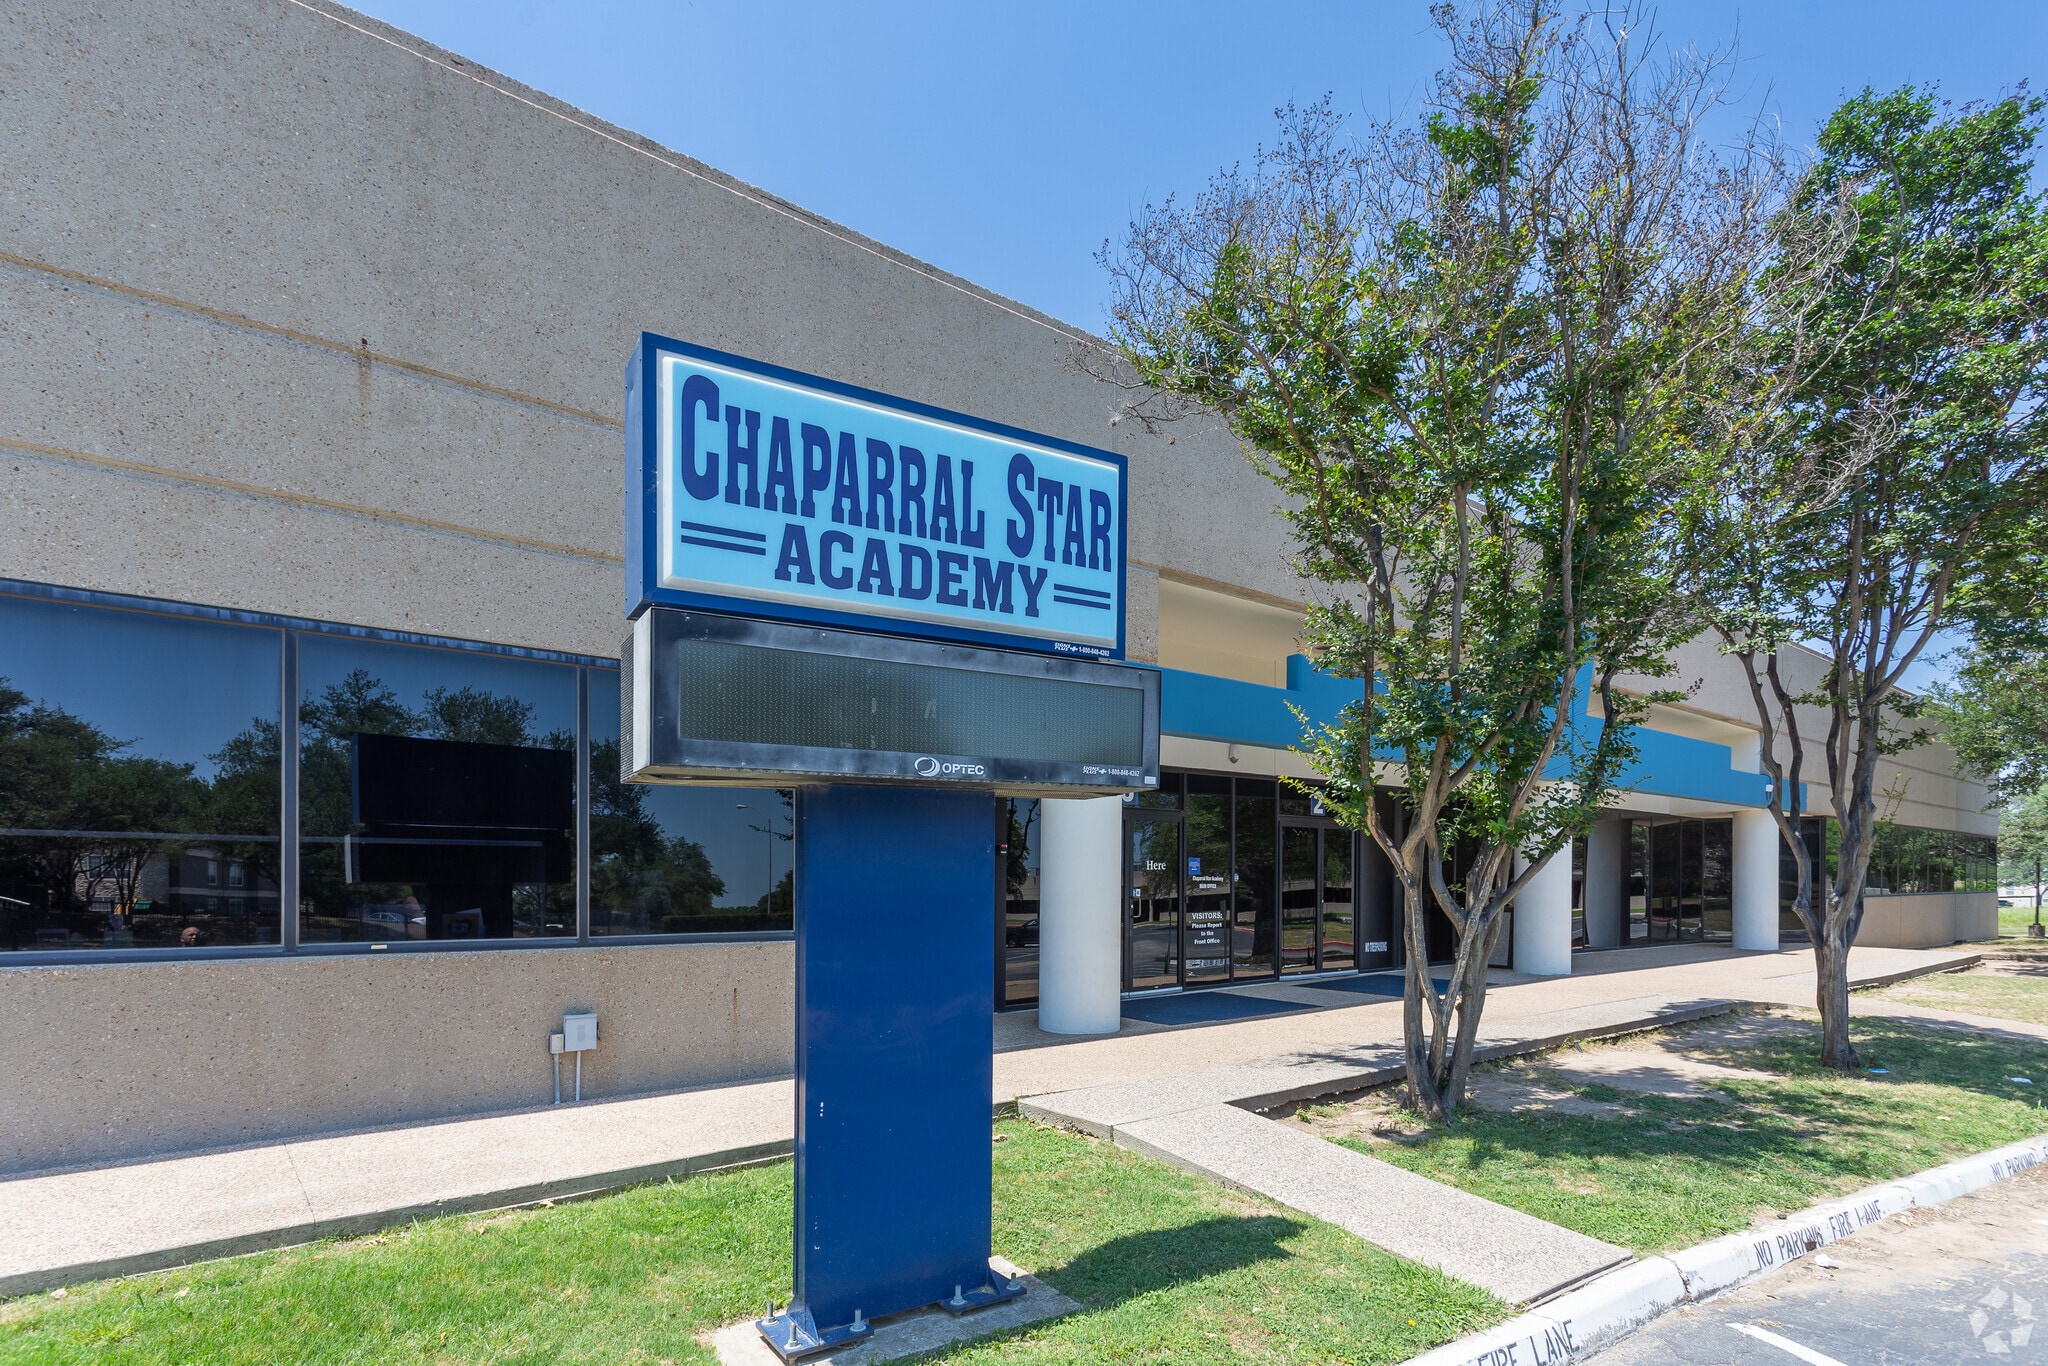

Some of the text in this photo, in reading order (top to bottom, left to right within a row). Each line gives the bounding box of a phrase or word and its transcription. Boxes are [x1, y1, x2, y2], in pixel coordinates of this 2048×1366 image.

[681, 374, 1112, 572] CHAPARRAL STAR
[774, 523, 1048, 618] ACADEMY
[942, 763, 985, 776] OPTEC
[1146, 860, 1167, 871] Here
[1191, 911, 1223, 920] VISITORS:
[1753, 1240, 1774, 1269] NO
[1828, 1211, 1855, 1241] FIRE
[1529, 1318, 1581, 1366] LANE
